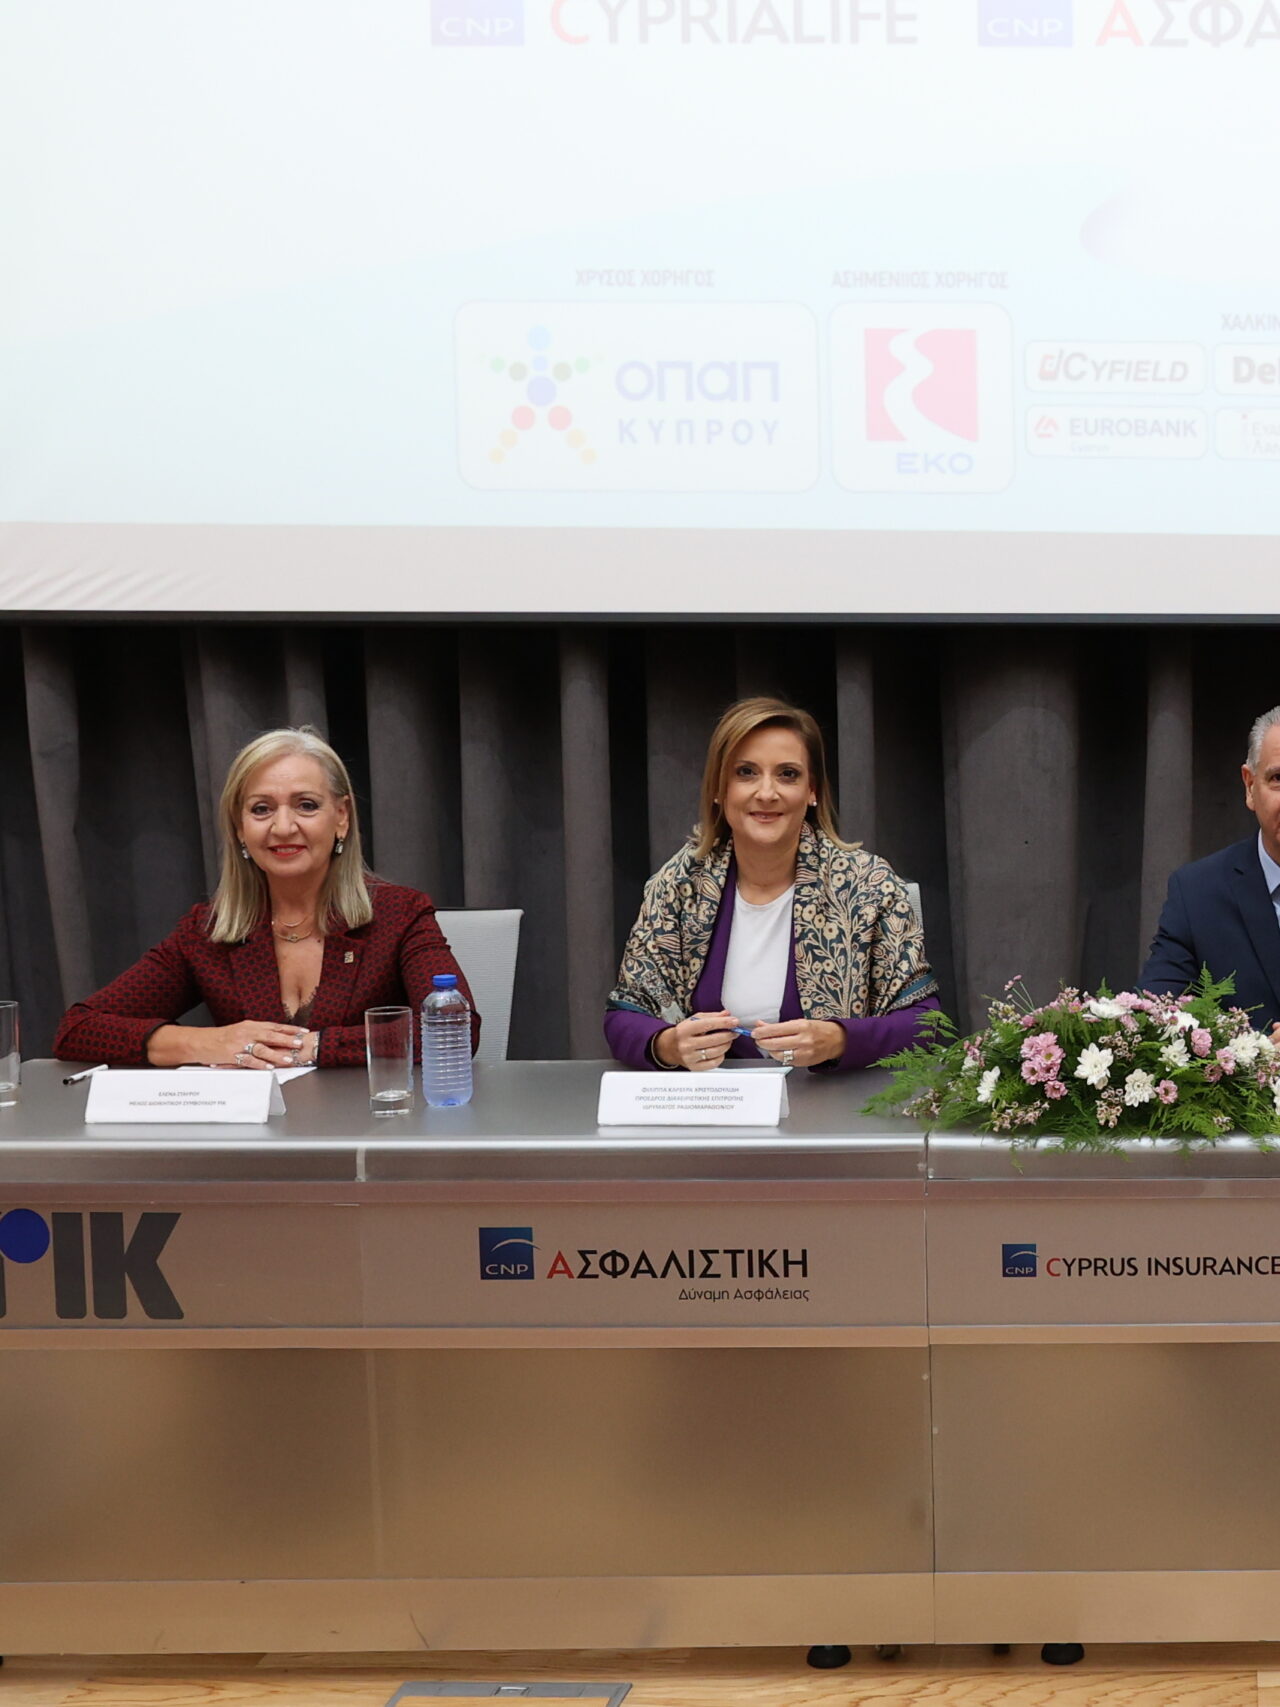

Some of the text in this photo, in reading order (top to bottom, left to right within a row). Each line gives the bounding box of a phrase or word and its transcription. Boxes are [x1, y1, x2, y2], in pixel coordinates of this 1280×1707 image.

[439, 16, 516, 39] CNP
[549, 0, 919, 45] CYPRIALIFE
[986, 16, 1064, 40] CNP
[618, 419, 779, 446] ΚΥΠΡΟΥ
[1069, 418, 1198, 439] EUROBANK
[896, 453, 974, 475] EKO
[485, 1264, 528, 1275] CNP
[546, 1249, 808, 1279] ΑΣΦΑΛΙΣΤΙΚΗ
[1005, 1267, 1034, 1275] CNP
[1046, 1258, 1138, 1277] CYPRUS
[678, 1287, 810, 1303] Δύναμη Ασφάλειας
